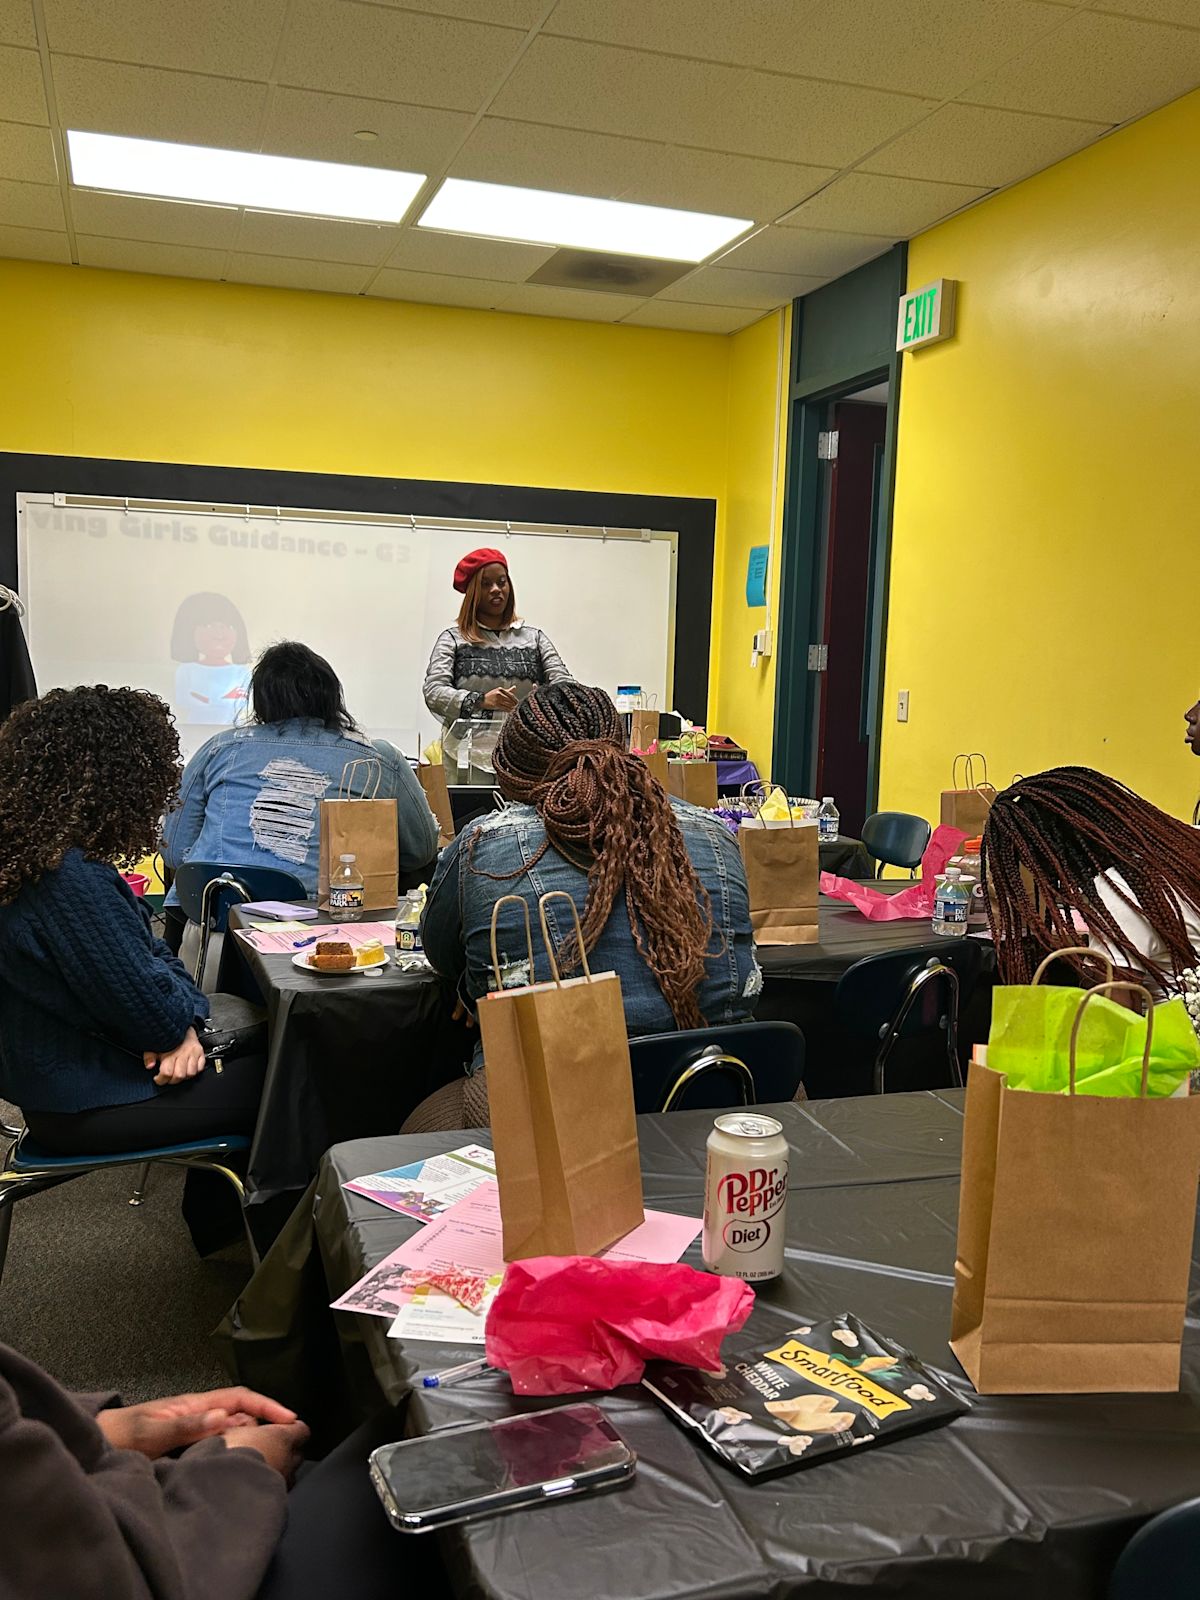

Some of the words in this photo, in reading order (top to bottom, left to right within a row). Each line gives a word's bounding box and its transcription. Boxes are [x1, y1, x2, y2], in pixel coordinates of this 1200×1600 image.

[904, 288, 937, 343] EXIT
[119, 515, 198, 543] Girls
[207, 524, 348, 557] Guidance
[375, 542, 411, 564] G3
[718, 1172, 788, 1217] Pepper
[749, 1168, 778, 1193] Dr
[732, 1228, 761, 1245] Diet
[735, 1362, 780, 1401] CHEDDAR
[754, 1360, 790, 1390] WHITE
[780, 1349, 894, 1407] Smartfood
